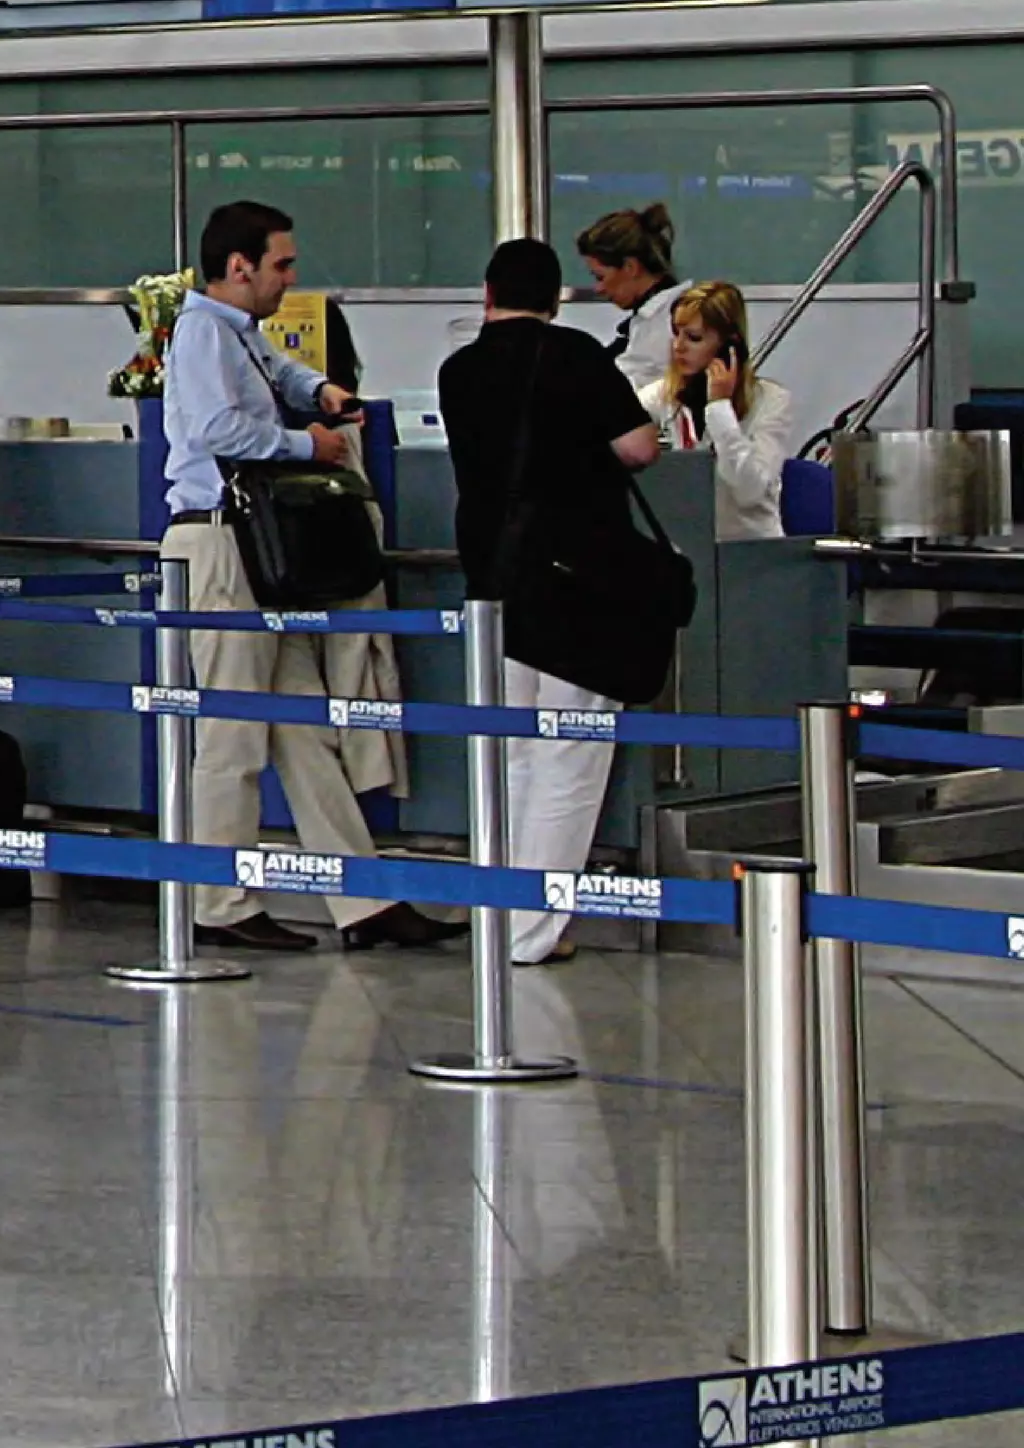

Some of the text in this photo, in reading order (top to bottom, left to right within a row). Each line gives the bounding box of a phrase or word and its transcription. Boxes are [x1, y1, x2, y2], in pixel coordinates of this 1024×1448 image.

[152, 687, 199, 702] ATHENS
[349, 701, 402, 716] ATHENS
[559, 712, 616, 726] ATHENS
[265, 853, 342, 874] ATHENS
[577, 874, 661, 897] ATHENS
[751, 1360, 883, 1406] ATHENS
